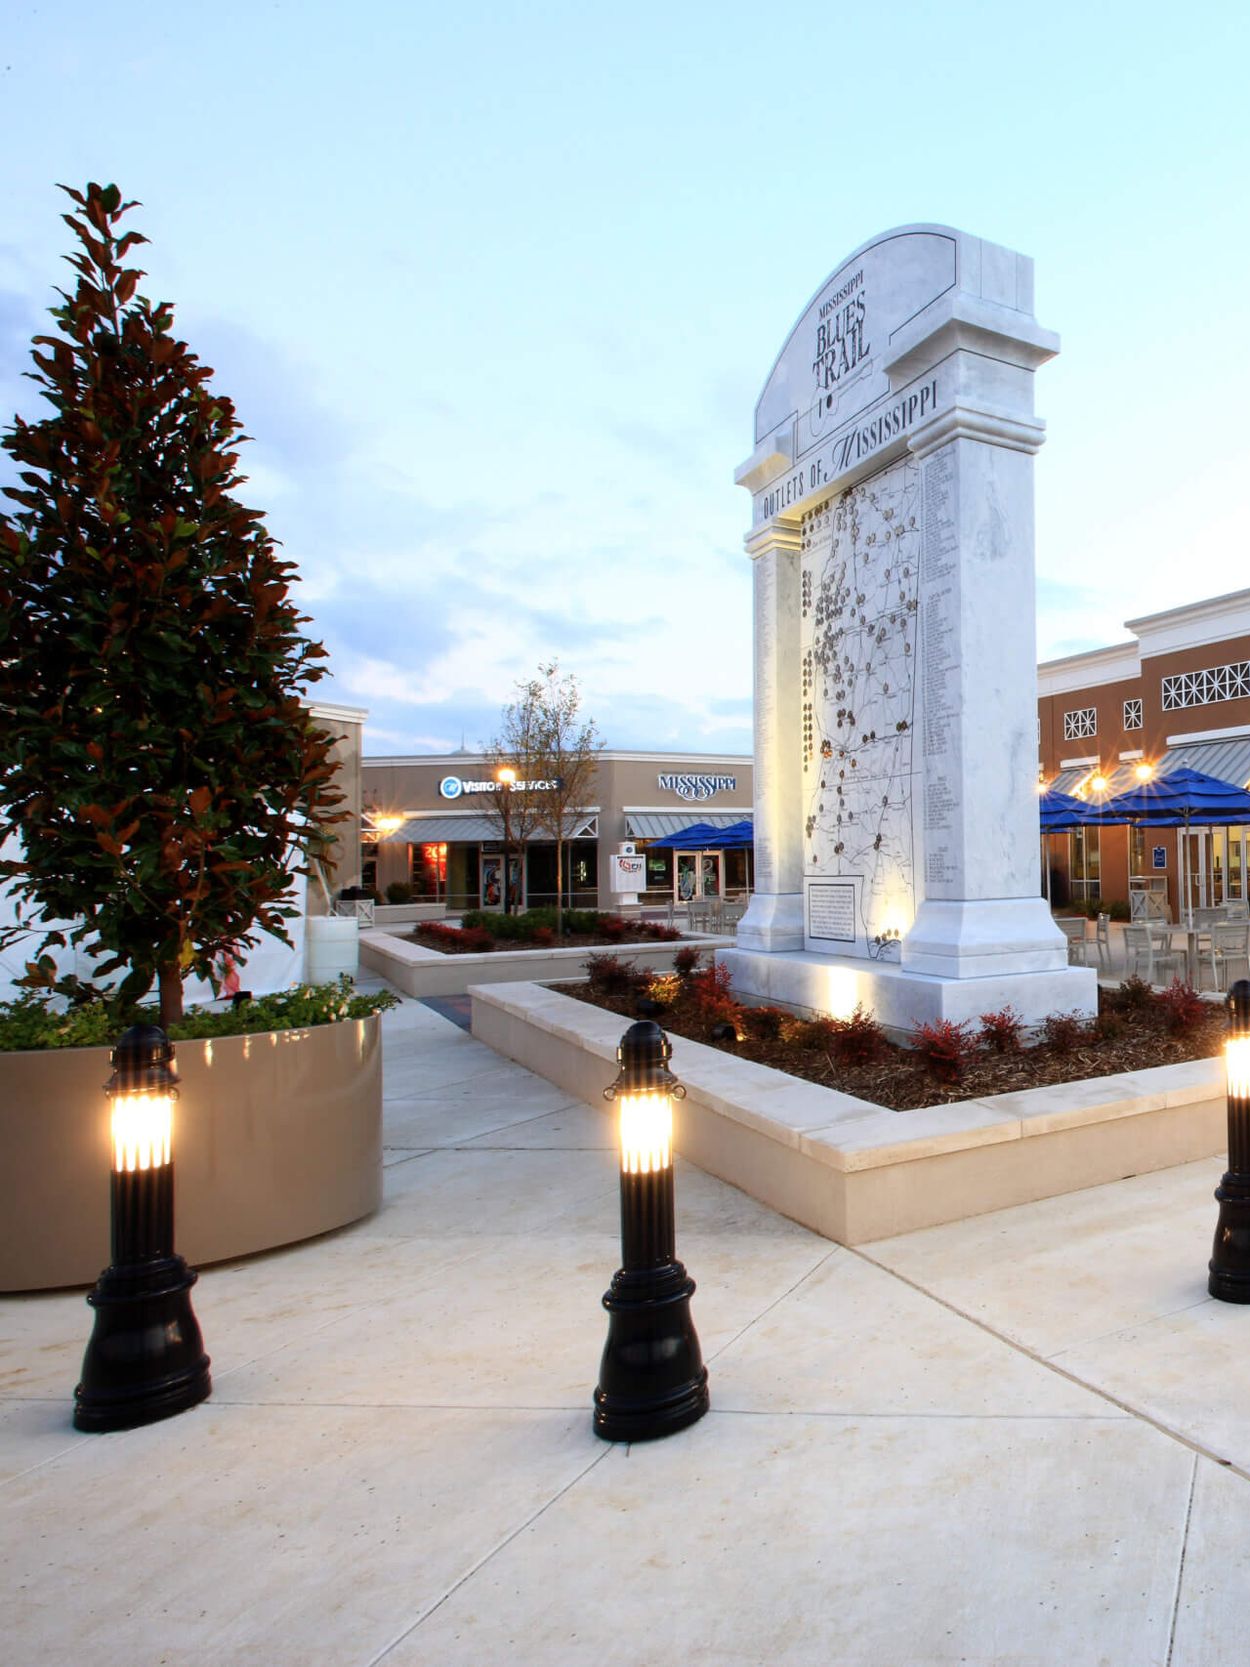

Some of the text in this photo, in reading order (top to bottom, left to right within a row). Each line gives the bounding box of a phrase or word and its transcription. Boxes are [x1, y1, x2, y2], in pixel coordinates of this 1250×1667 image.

[816, 289, 866, 359] BLUES
[819, 269, 864, 319] MISSISSIPPI
[812, 316, 870, 390] TRAIL
[763, 472, 804, 520] OUTLETS
[810, 459, 822, 489] OF
[659, 775, 736, 801] MISSISSIPPI
